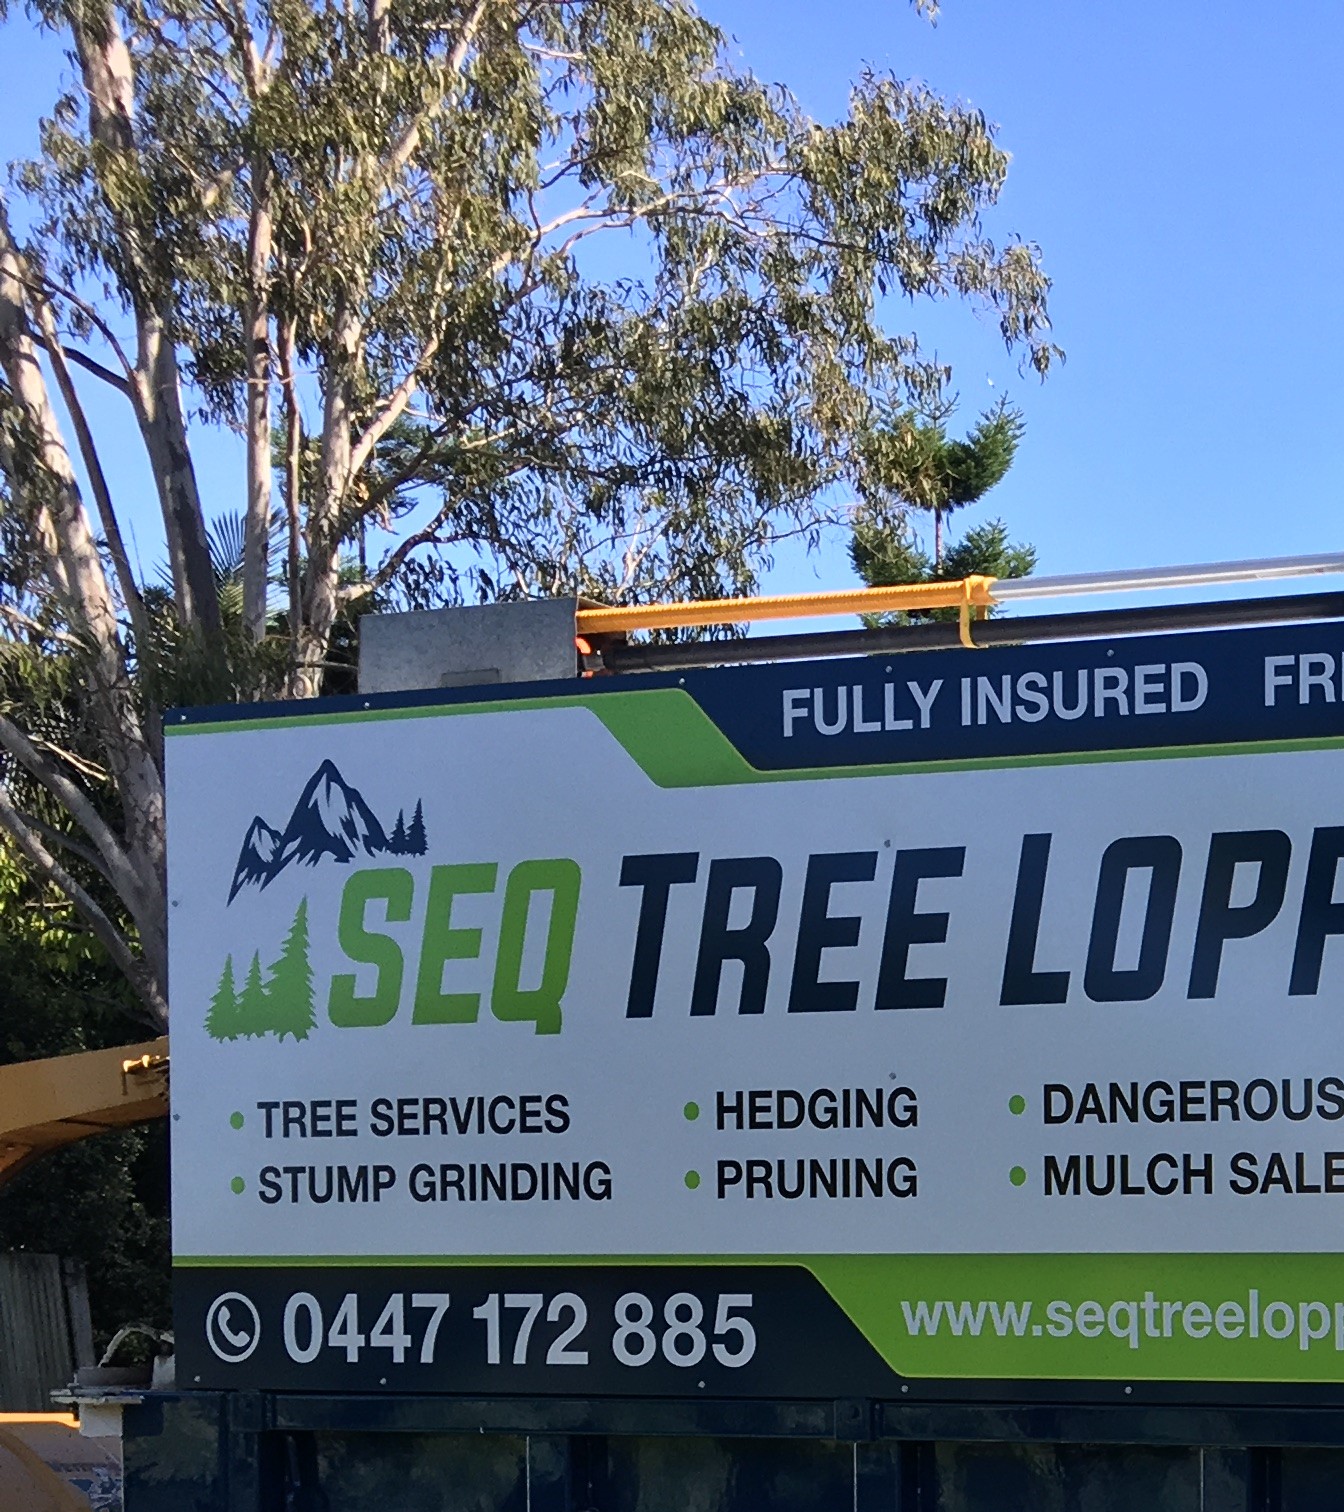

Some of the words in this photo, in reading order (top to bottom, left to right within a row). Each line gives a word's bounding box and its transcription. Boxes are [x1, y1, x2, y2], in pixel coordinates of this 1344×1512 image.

[782, 679, 942, 738] FULLY
[962, 661, 1208, 725] INSURED
[329, 857, 582, 1035] SEQ
[619, 847, 966, 1018] TREE
[258, 1101, 356, 1138] TREE
[371, 1095, 570, 1135] SERVICES
[717, 1087, 918, 1130] HEDGING
[259, 1165, 395, 1203] STUMP
[409, 1162, 612, 1201] GRINDING
[717, 1158, 918, 1199] PRUNING
[1044, 1153, 1213, 1196] MULCH
[283, 1293, 449, 1364] 0447
[473, 1293, 588, 1364] 172
[613, 1293, 755, 1366] 885
